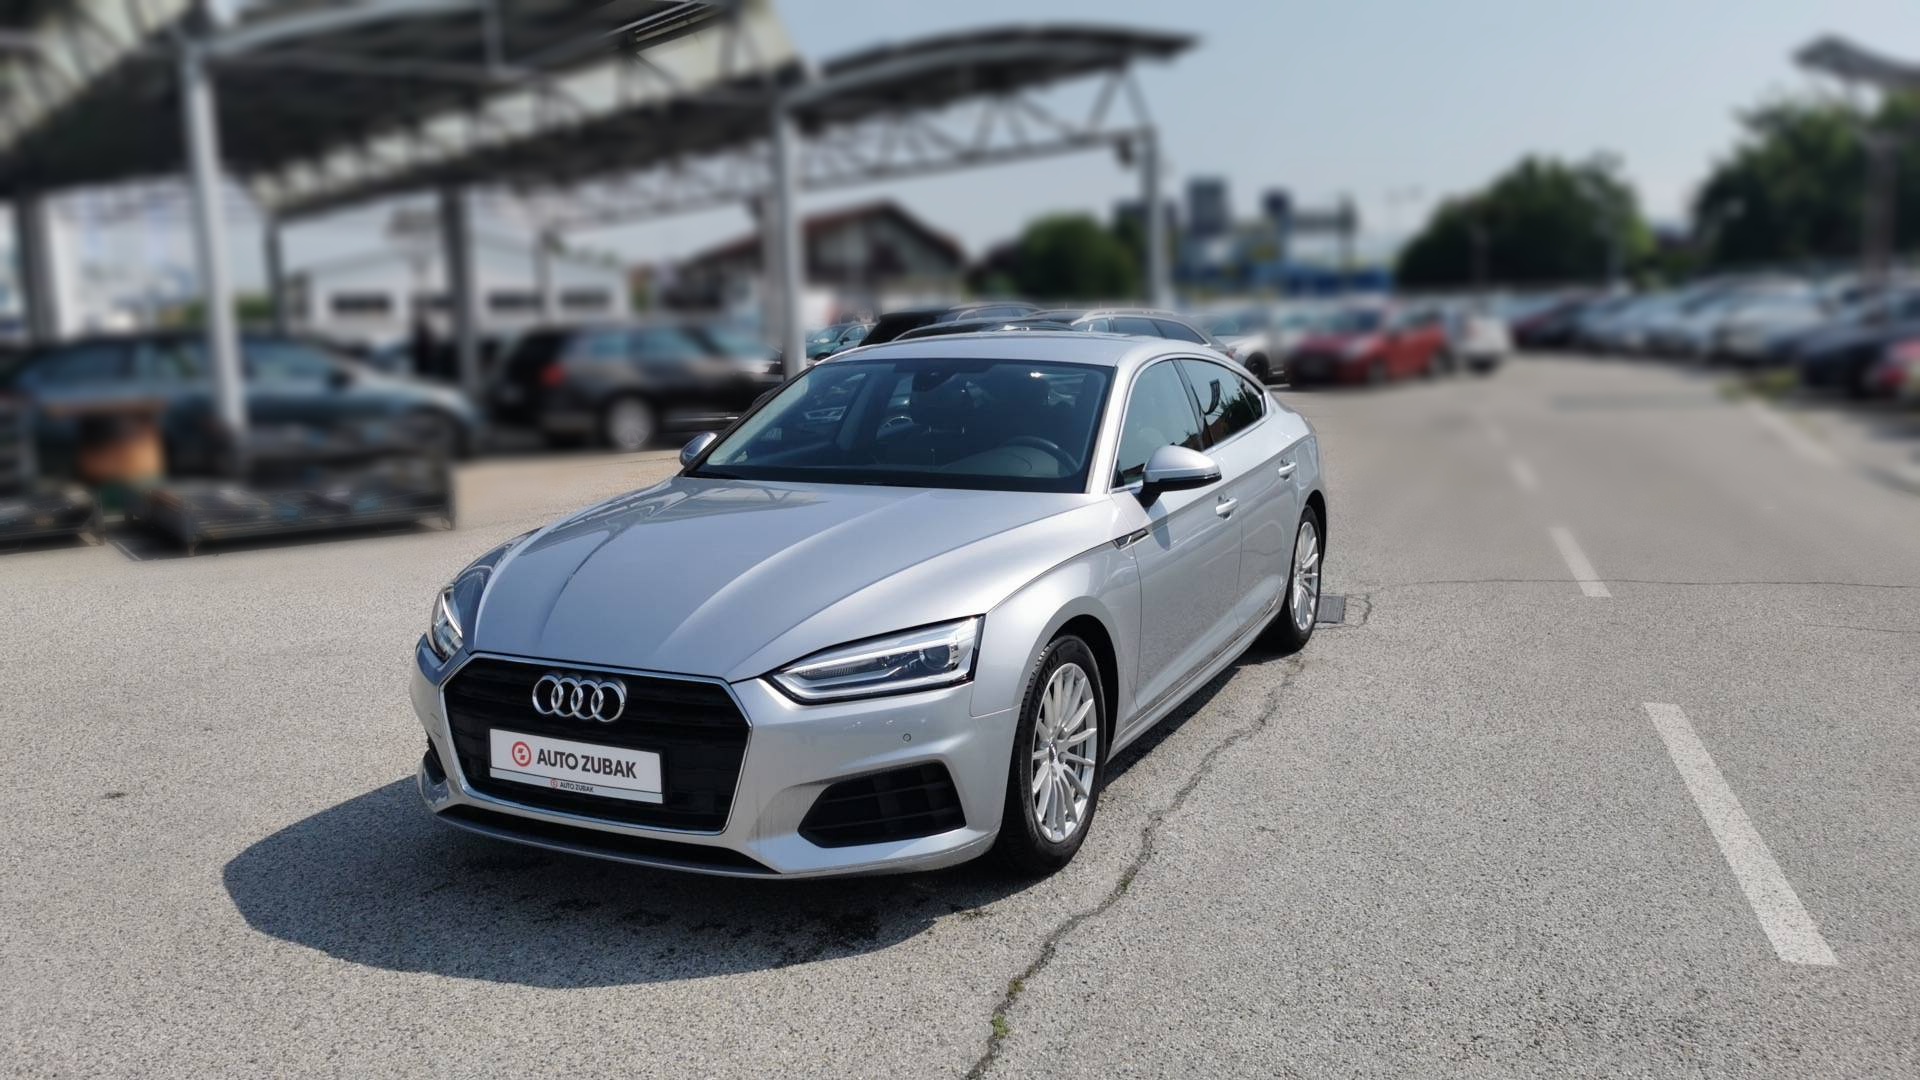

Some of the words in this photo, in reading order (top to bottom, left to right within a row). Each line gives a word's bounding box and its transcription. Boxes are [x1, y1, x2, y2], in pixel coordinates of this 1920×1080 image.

[537, 749, 578, 770] AUTO
[581, 755, 637, 779] ZUBAK
[560, 782, 574, 790] AUTO
[575, 784, 594, 792] ZUBAK
